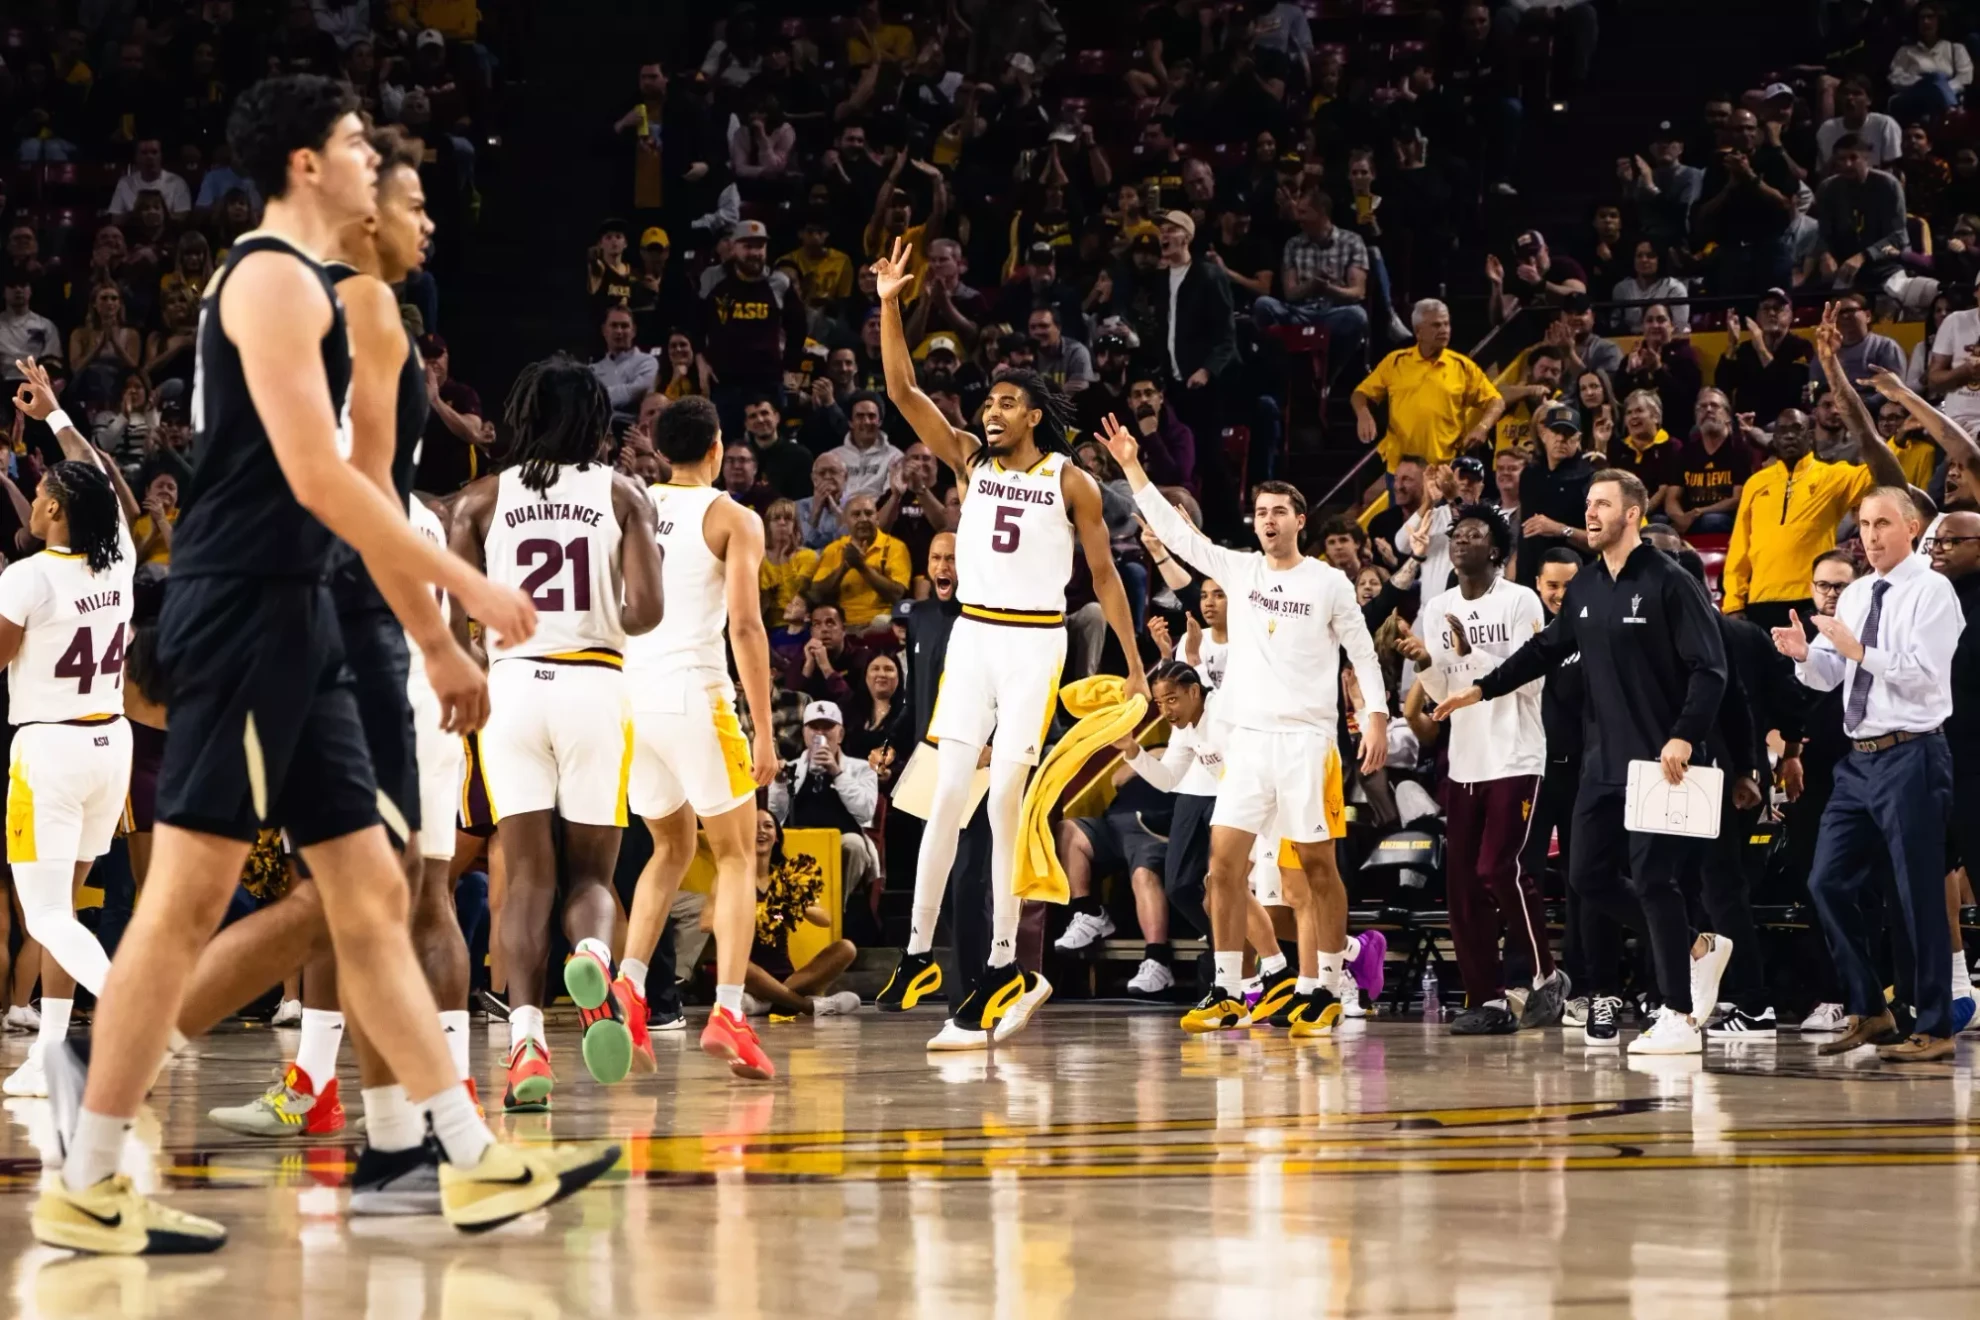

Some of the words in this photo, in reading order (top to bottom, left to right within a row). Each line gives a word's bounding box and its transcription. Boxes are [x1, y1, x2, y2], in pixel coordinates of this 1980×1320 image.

[733, 301, 769, 320] ASU
[1684, 470, 1704, 487] SUN
[978, 479, 1006, 499] SUN
[1006, 485, 1055, 506] DEVILS
[504, 503, 604, 529] QUAINTANCE
[992, 505, 1025, 554] 5
[516, 536, 591, 612] 21
[74, 590, 121, 615] MILLER
[1282, 601, 1311, 616] STATE
[1469, 623, 1510, 645] DEVIL
[54, 622, 126, 694] 44
[533, 669, 556, 681] ASU
[93, 736, 110, 747] ASU
